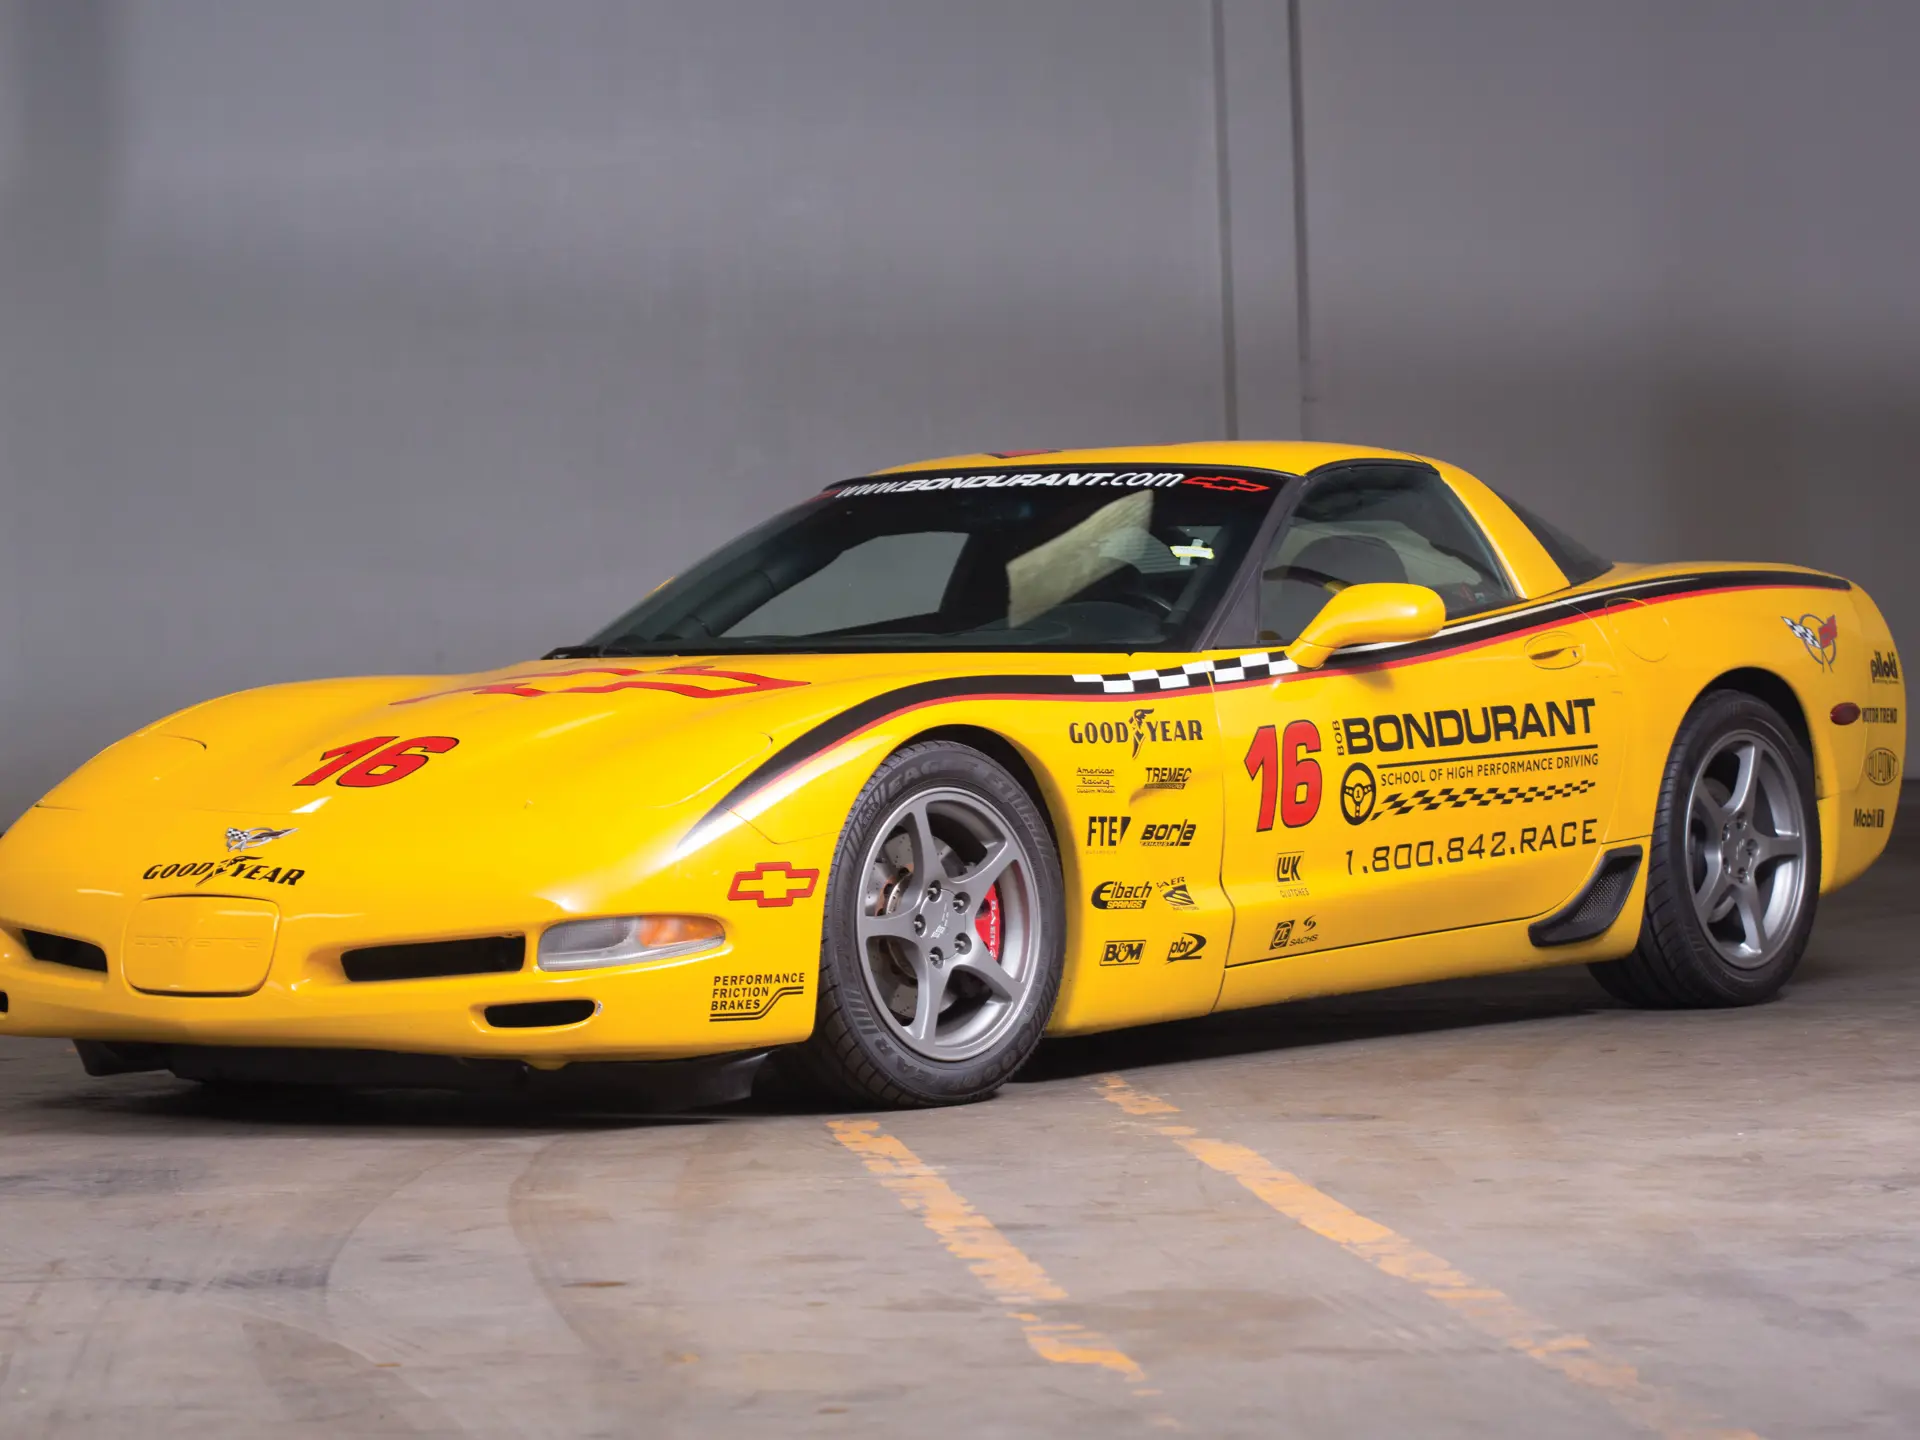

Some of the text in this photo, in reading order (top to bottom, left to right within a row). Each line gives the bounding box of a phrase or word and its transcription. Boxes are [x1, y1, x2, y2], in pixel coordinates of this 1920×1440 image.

[835, 472, 1186, 498] www.BONDURANT.com
[1332, 719, 1345, 756] BOB
[1342, 698, 1595, 755] BONDURANT
[291, 735, 460, 788] 16
[1144, 767, 1192, 782] TREMEC
[1381, 752, 1599, 787] SCHOOL OF HIGH PERFORMANCE DRIVING
[1244, 719, 1322, 833] 16
[1087, 816, 1117, 846] FTE
[1853, 808, 1876, 828] Mobil
[1345, 818, 1598, 876] 1.800.842.RACE
[1091, 881, 1153, 909] Eibach
[1106, 900, 1143, 909] SPRINGS
[1289, 933, 1319, 947] SACHS
[712, 986, 769, 999] FRICTION
[713, 972, 806, 986] PERFORMANCE
[711, 999, 761, 1011] BRAKES
